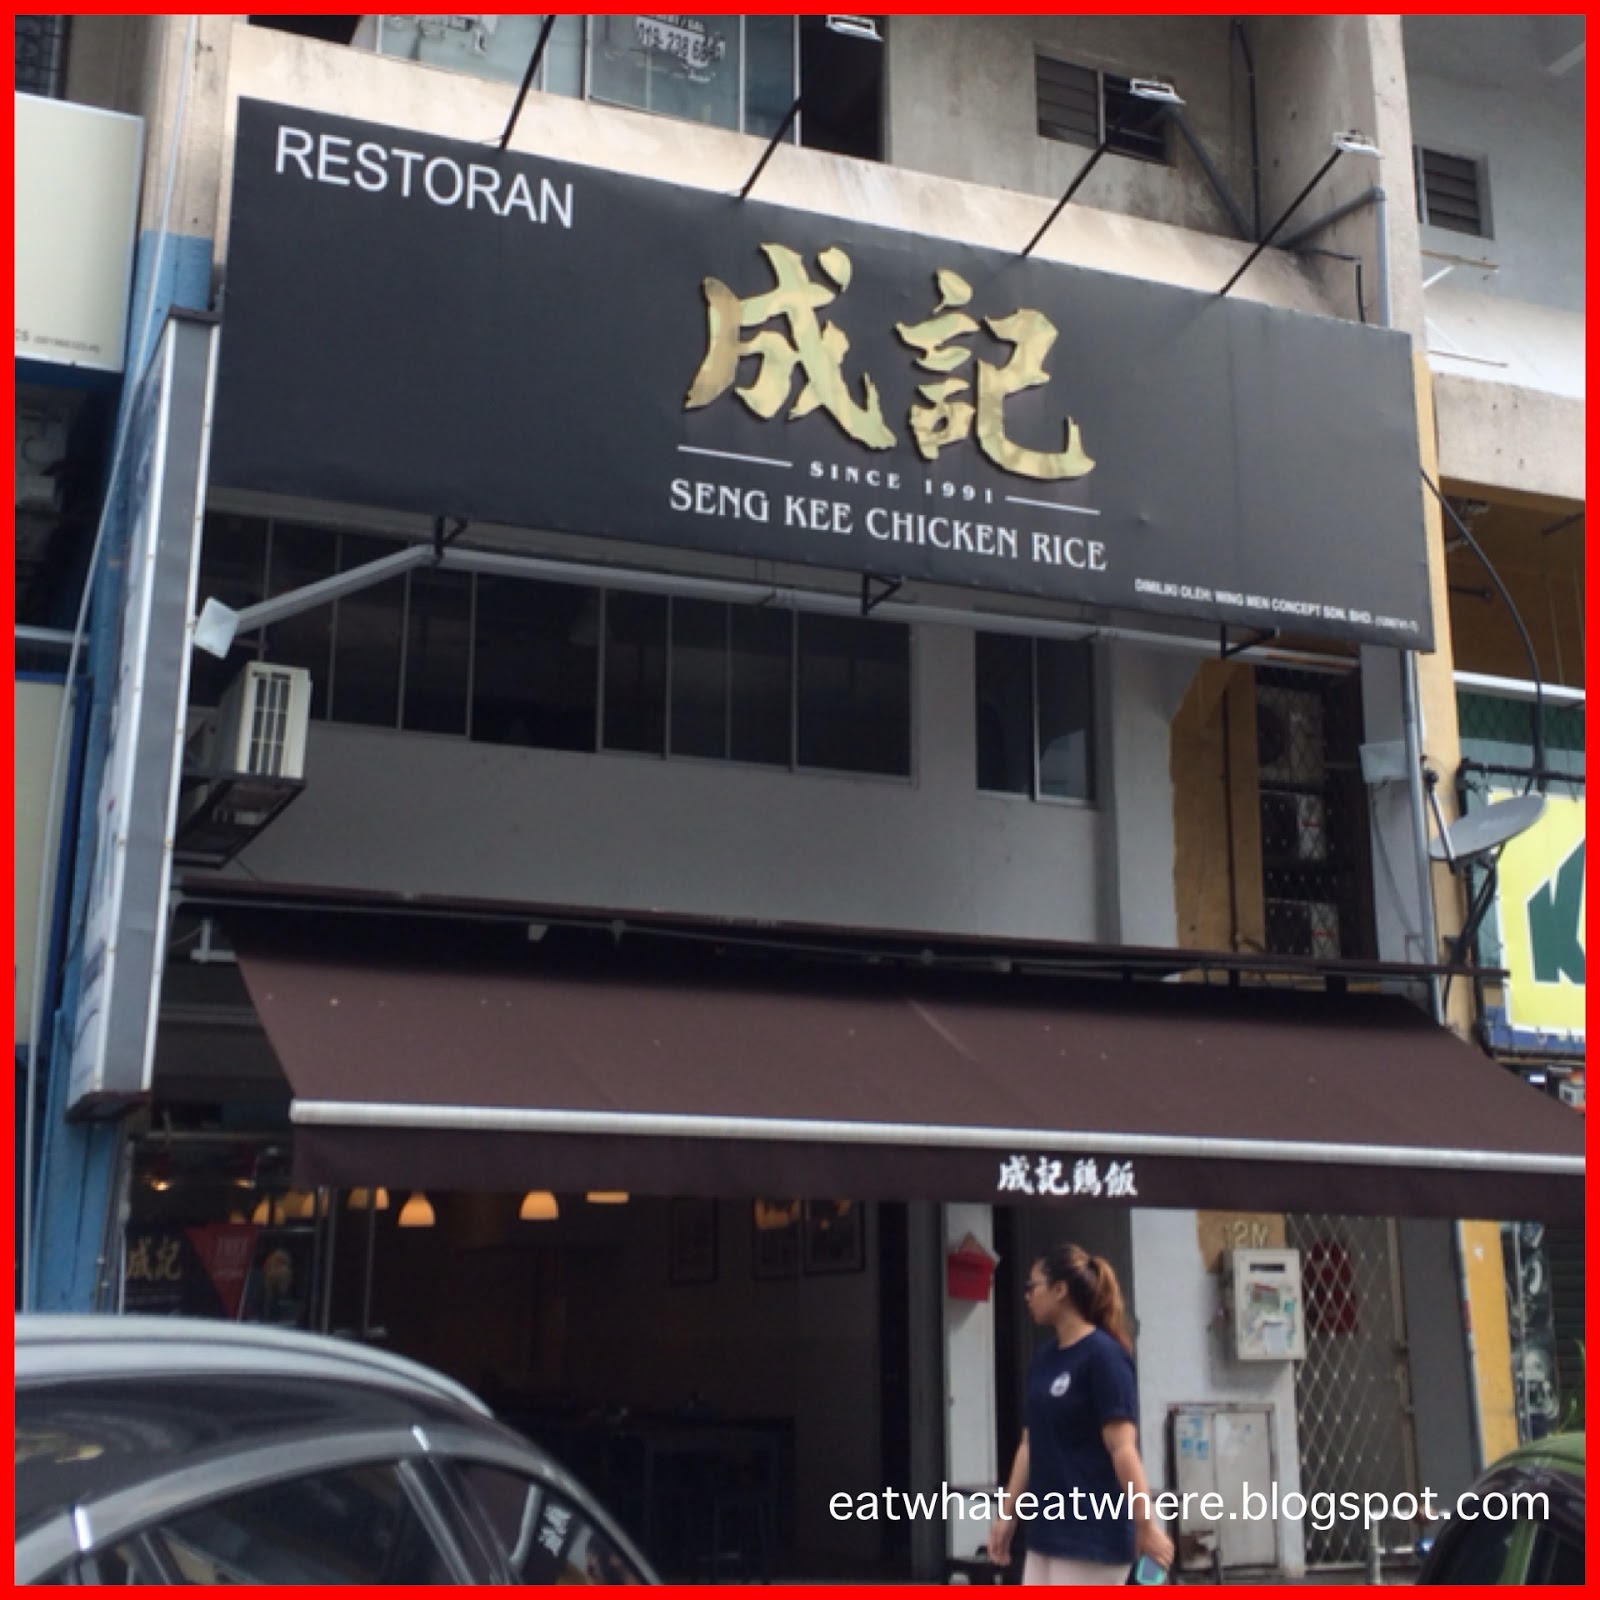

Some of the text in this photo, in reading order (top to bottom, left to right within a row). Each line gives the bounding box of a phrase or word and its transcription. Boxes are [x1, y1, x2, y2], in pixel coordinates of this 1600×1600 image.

[275, 124, 574, 230] RESTORAN
[684, 242, 1097, 480] 成記
[669, 478, 1108, 572] SENG KEE CHICKEN RICE
[810, 460, 994, 504] SINCE 1991
[1272, 598, 1321, 617] CONCEPT
